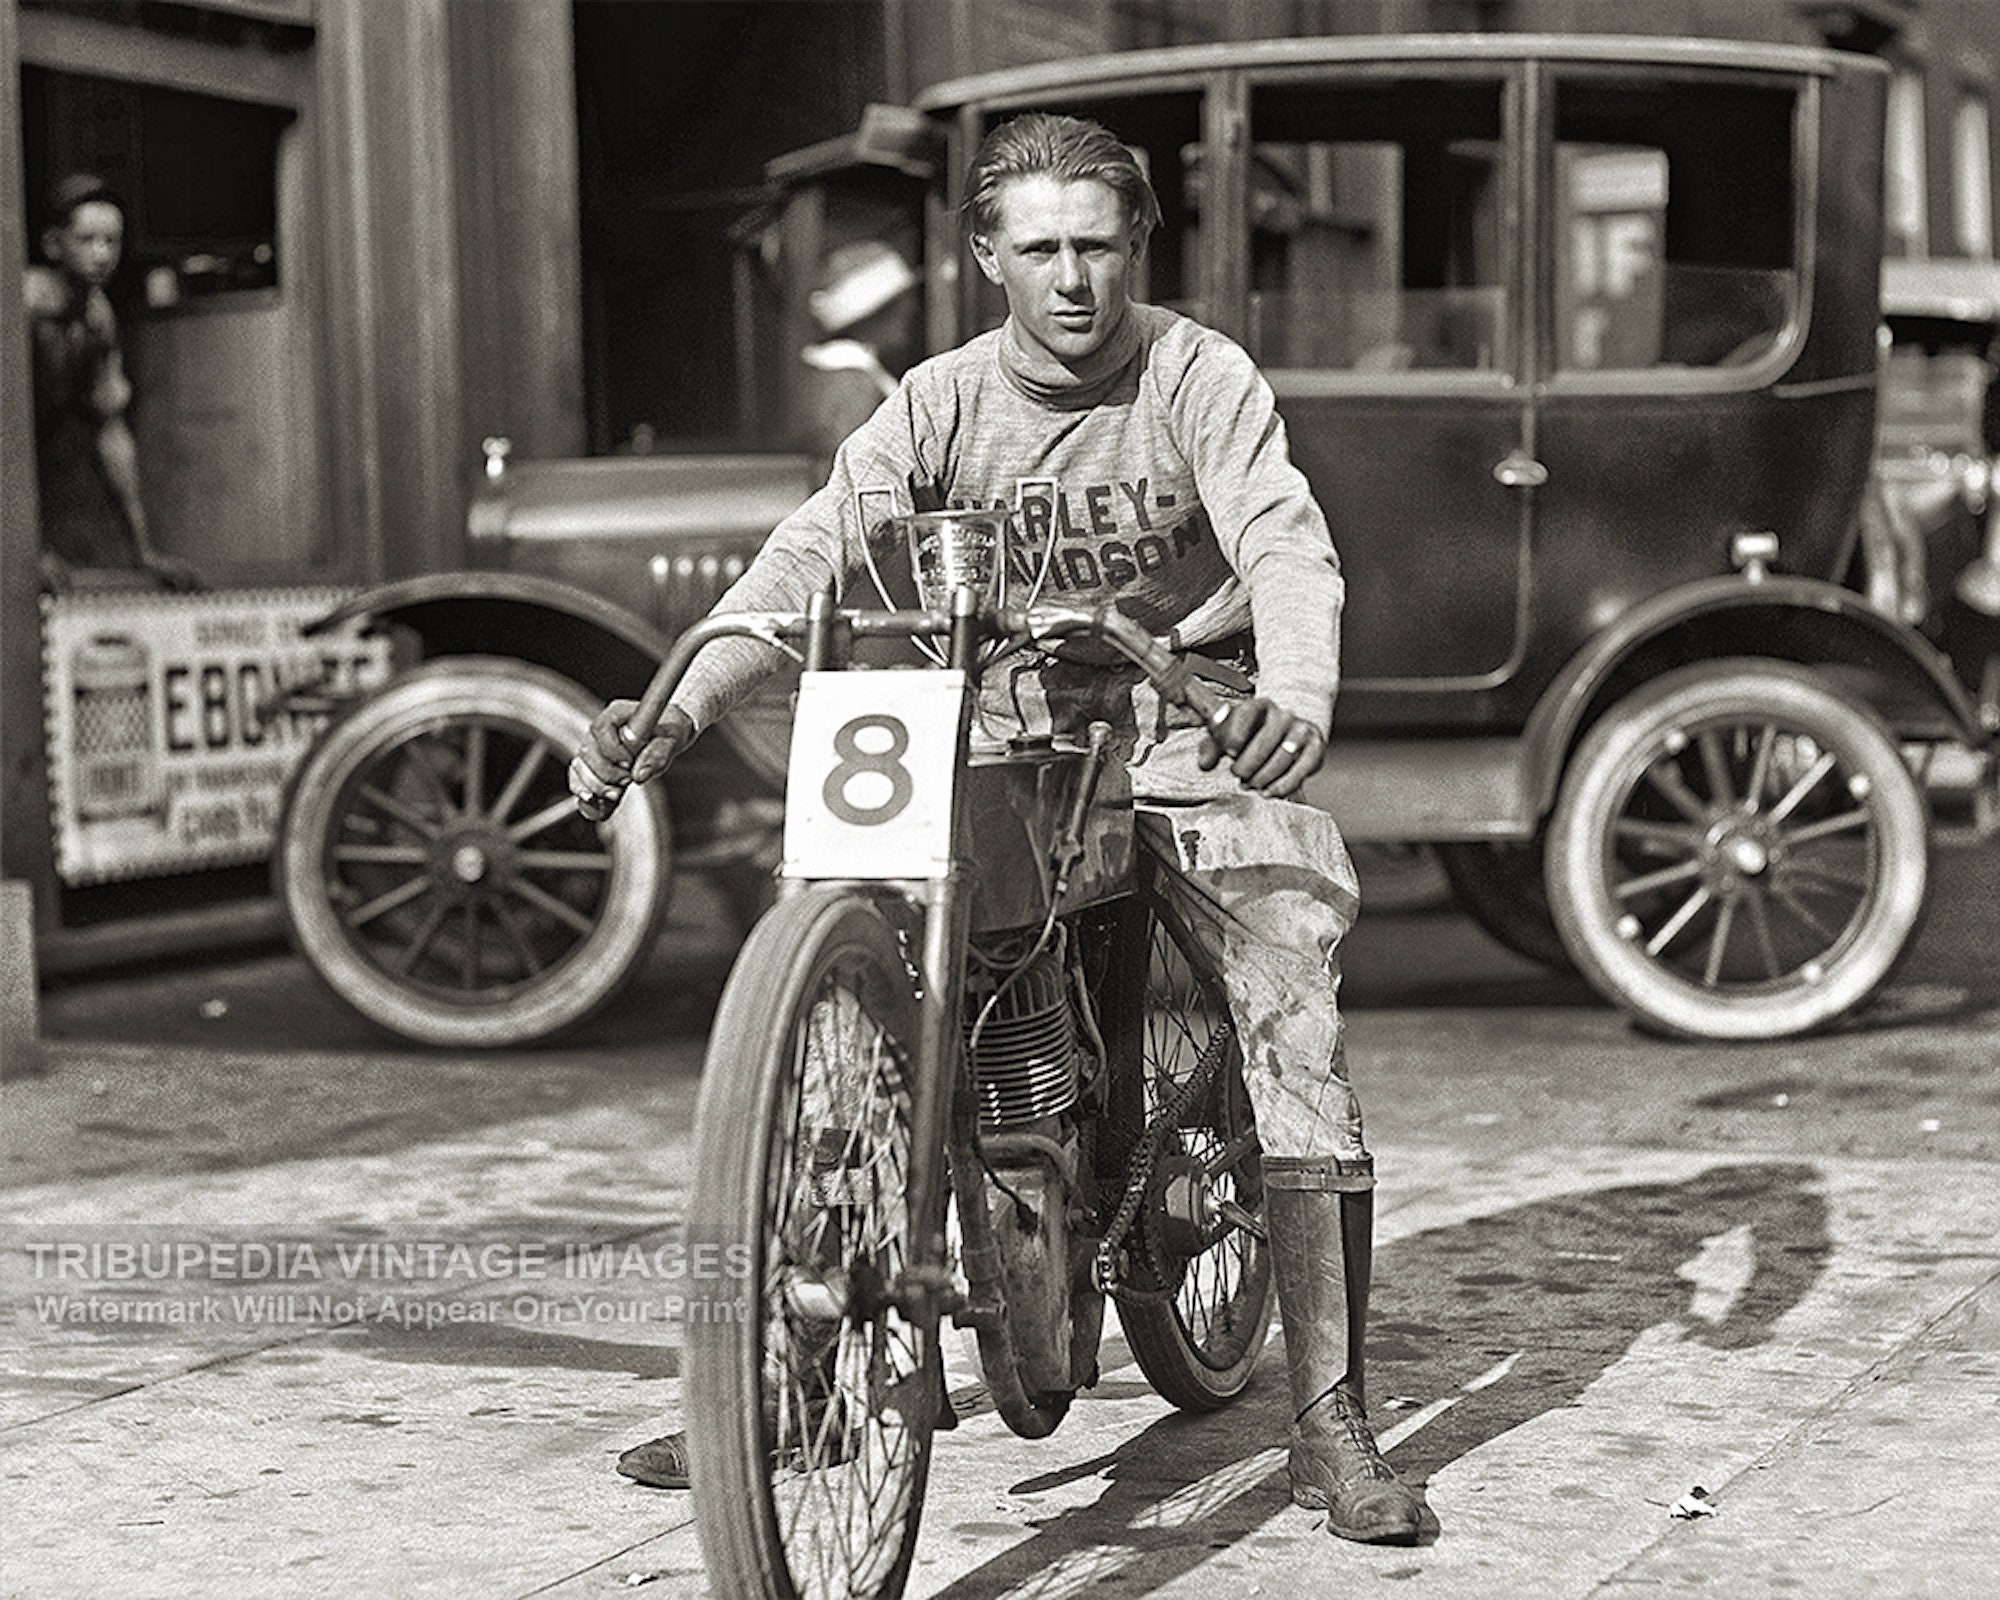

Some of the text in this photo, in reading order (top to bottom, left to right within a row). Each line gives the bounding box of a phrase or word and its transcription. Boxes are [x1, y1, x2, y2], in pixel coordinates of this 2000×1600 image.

[952, 478, 1175, 545] RLEY-
[1007, 513, 1200, 591] VIDSON
[822, 714, 913, 826] 8
